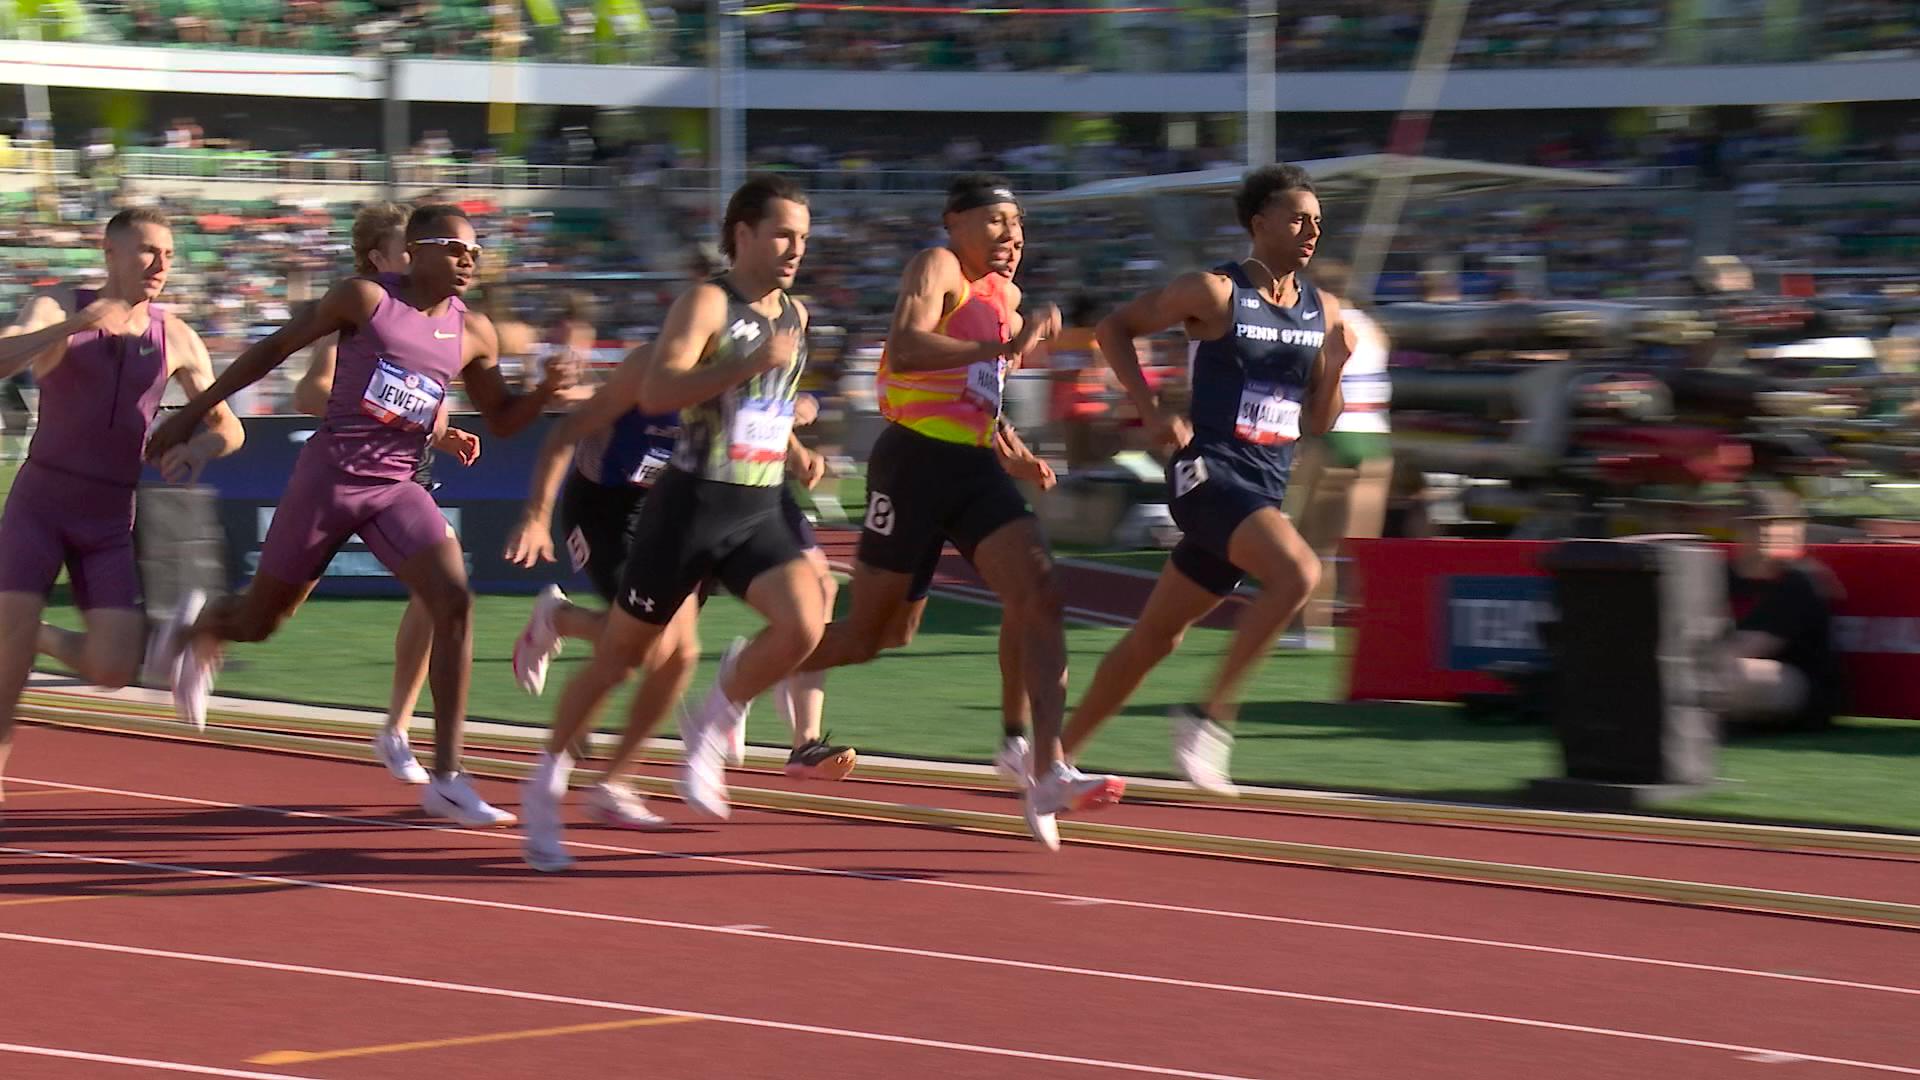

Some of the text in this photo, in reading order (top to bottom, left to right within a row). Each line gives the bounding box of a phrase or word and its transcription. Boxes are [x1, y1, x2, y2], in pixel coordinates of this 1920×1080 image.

[1236, 323, 1278, 341] PENN
[378, 383, 427, 415] JEWETT
[872, 497, 889, 529] 8
